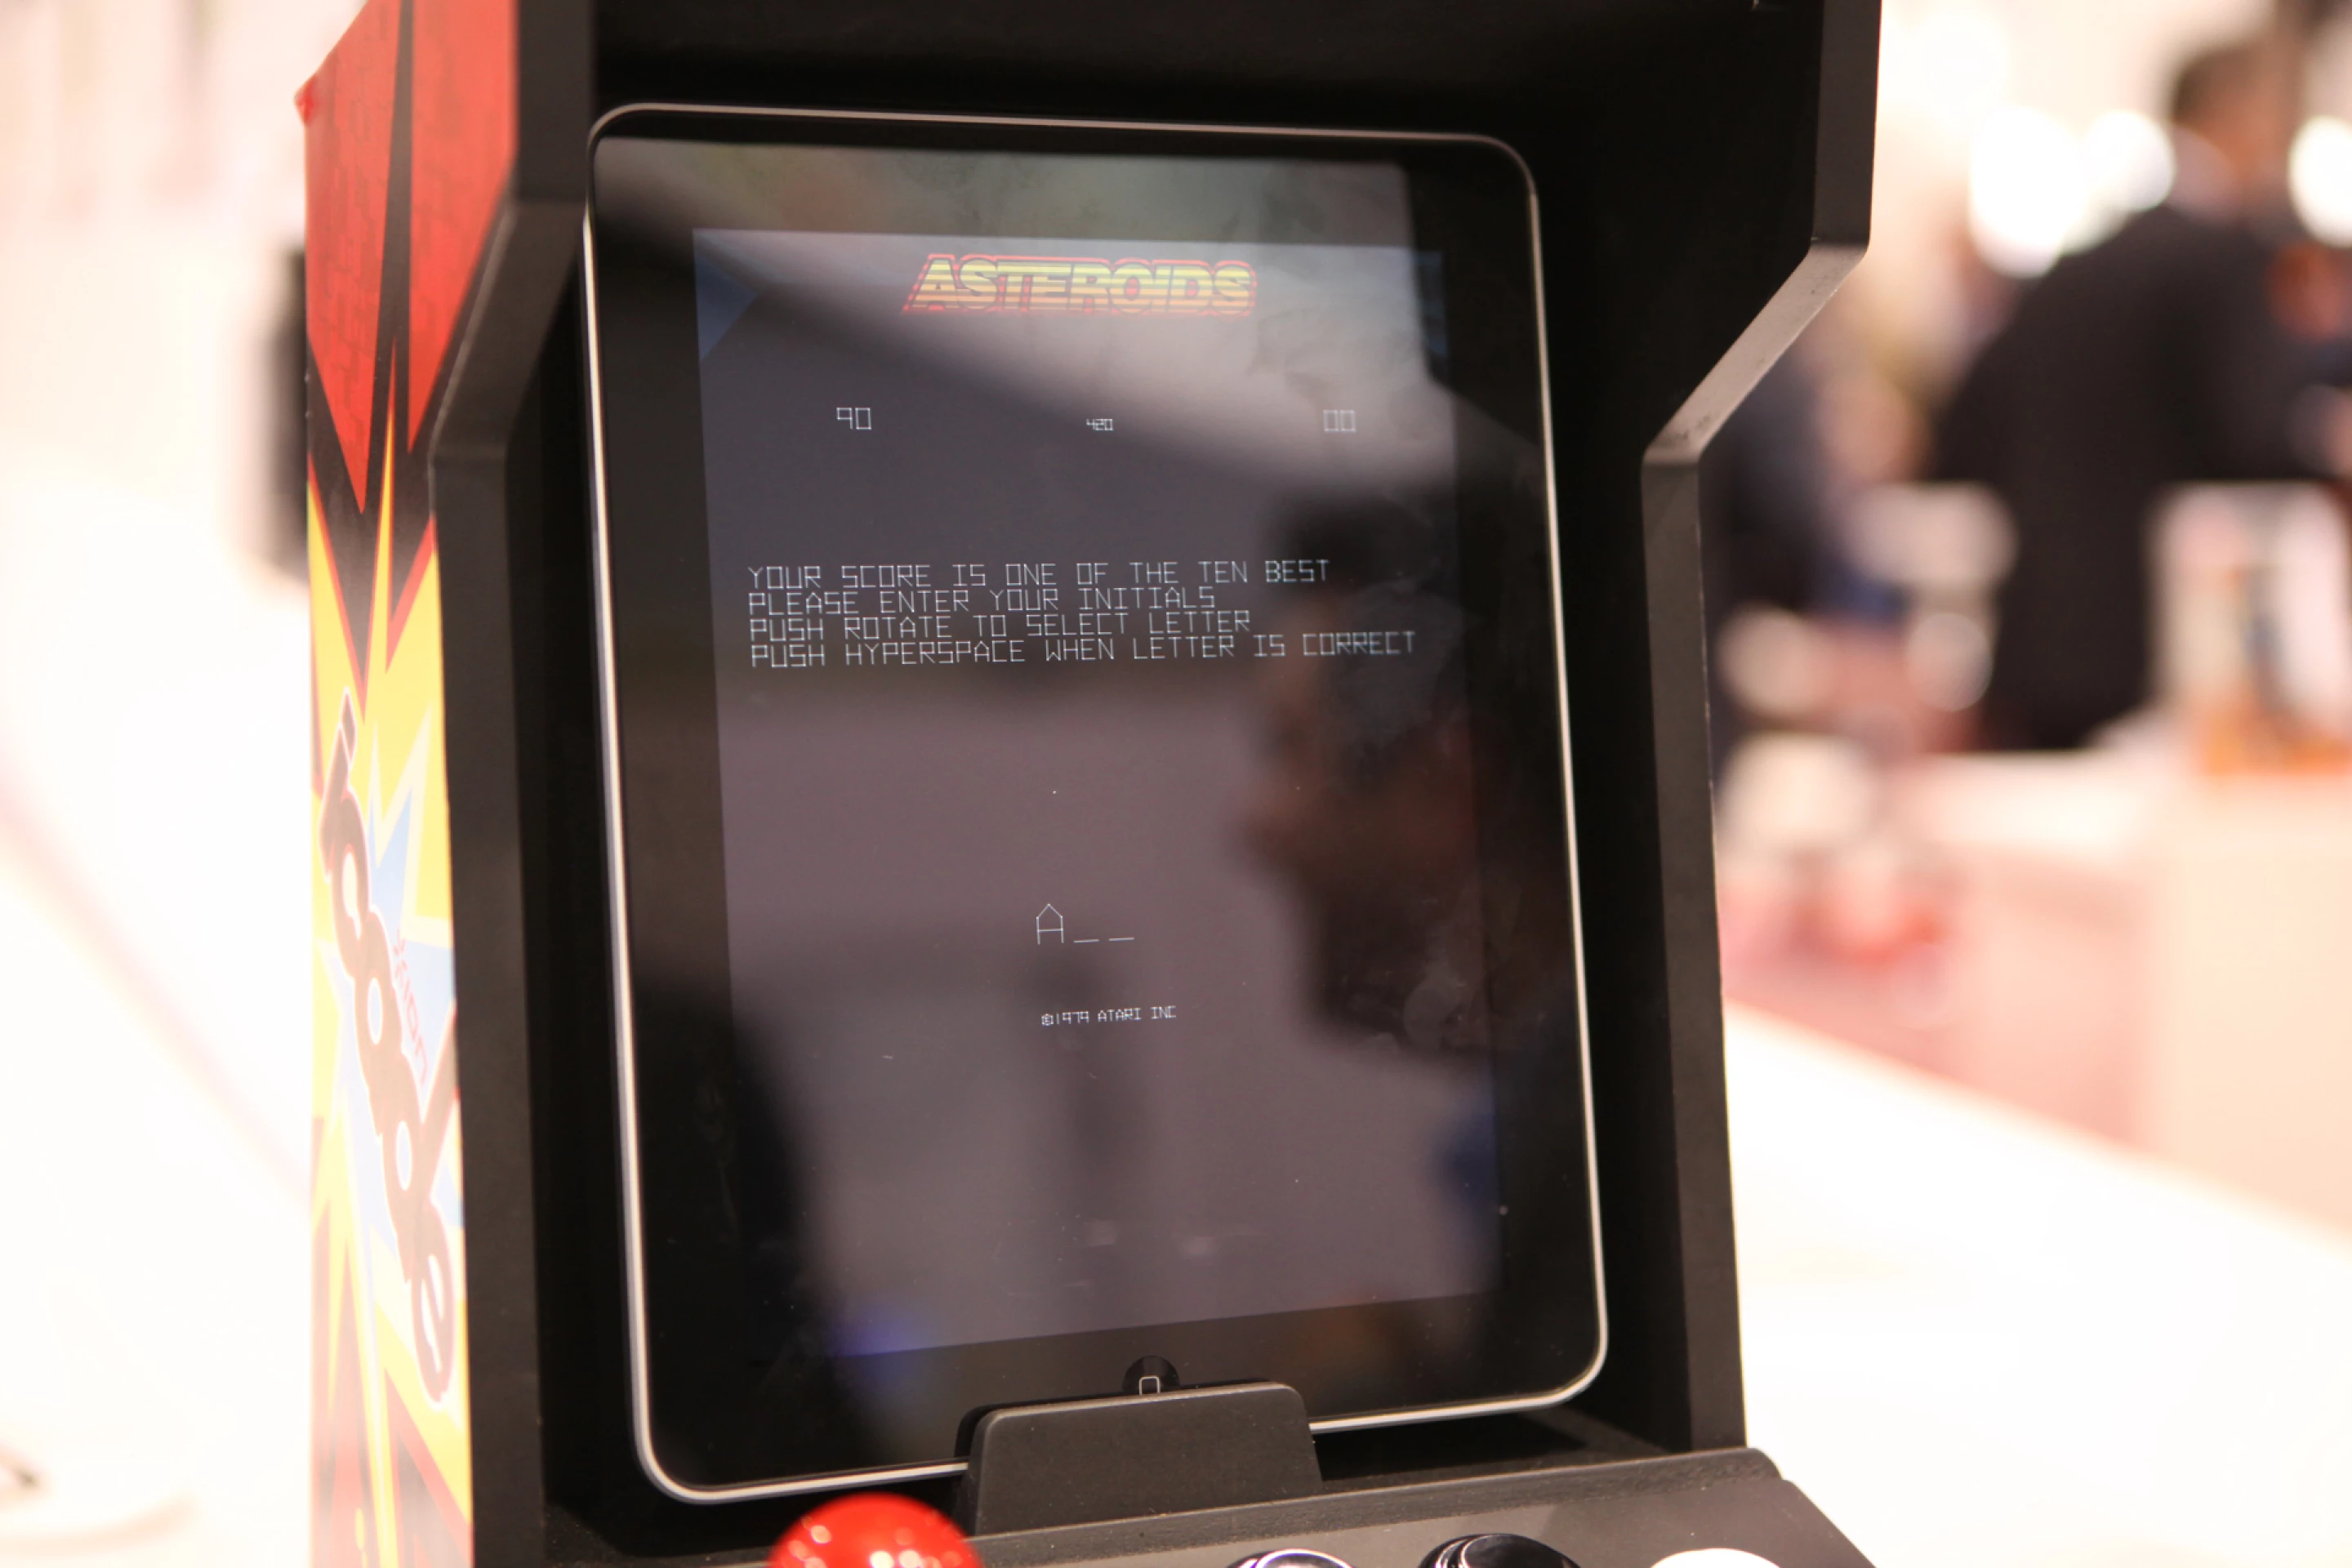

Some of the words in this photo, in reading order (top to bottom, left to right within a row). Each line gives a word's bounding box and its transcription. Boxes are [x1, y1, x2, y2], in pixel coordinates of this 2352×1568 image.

[902, 253, 1258, 318] ASTEROIDS
[835, 406, 872, 430] 90
[747, 565, 822, 590] YOUR
[840, 564, 932, 588] SCORE
[951, 564, 987, 586] IS
[1004, 563, 1057, 586] ONE
[1076, 562, 1109, 586] OF
[1129, 561, 1179, 585] THE
[1197, 559, 1248, 583] TEN
[1264, 559, 1330, 583] BEST
[748, 591, 861, 616] PLEASE
[880, 590, 969, 613] ENTER
[989, 588, 1059, 611] YOUR
[1077, 586, 1216, 610] INITIALS
[749, 617, 824, 642] PUSH
[844, 615, 953, 640] ROTATE
[972, 613, 1007, 637] TO
[1026, 612, 1129, 636] SELECT
[1148, 609, 1250, 635] LETTER
[751, 644, 826, 668] PUSH
[845, 639, 1026, 666] HYPERSPACE
[1045, 638, 1115, 662] WHEN
[1133, 635, 1235, 660] LETTER
[1253, 634, 1286, 657] IS
[1303, 630, 1416, 656] CORRECT
[1097, 1007, 1142, 1022] ATARI
[1150, 1004, 1177, 1020] INC
